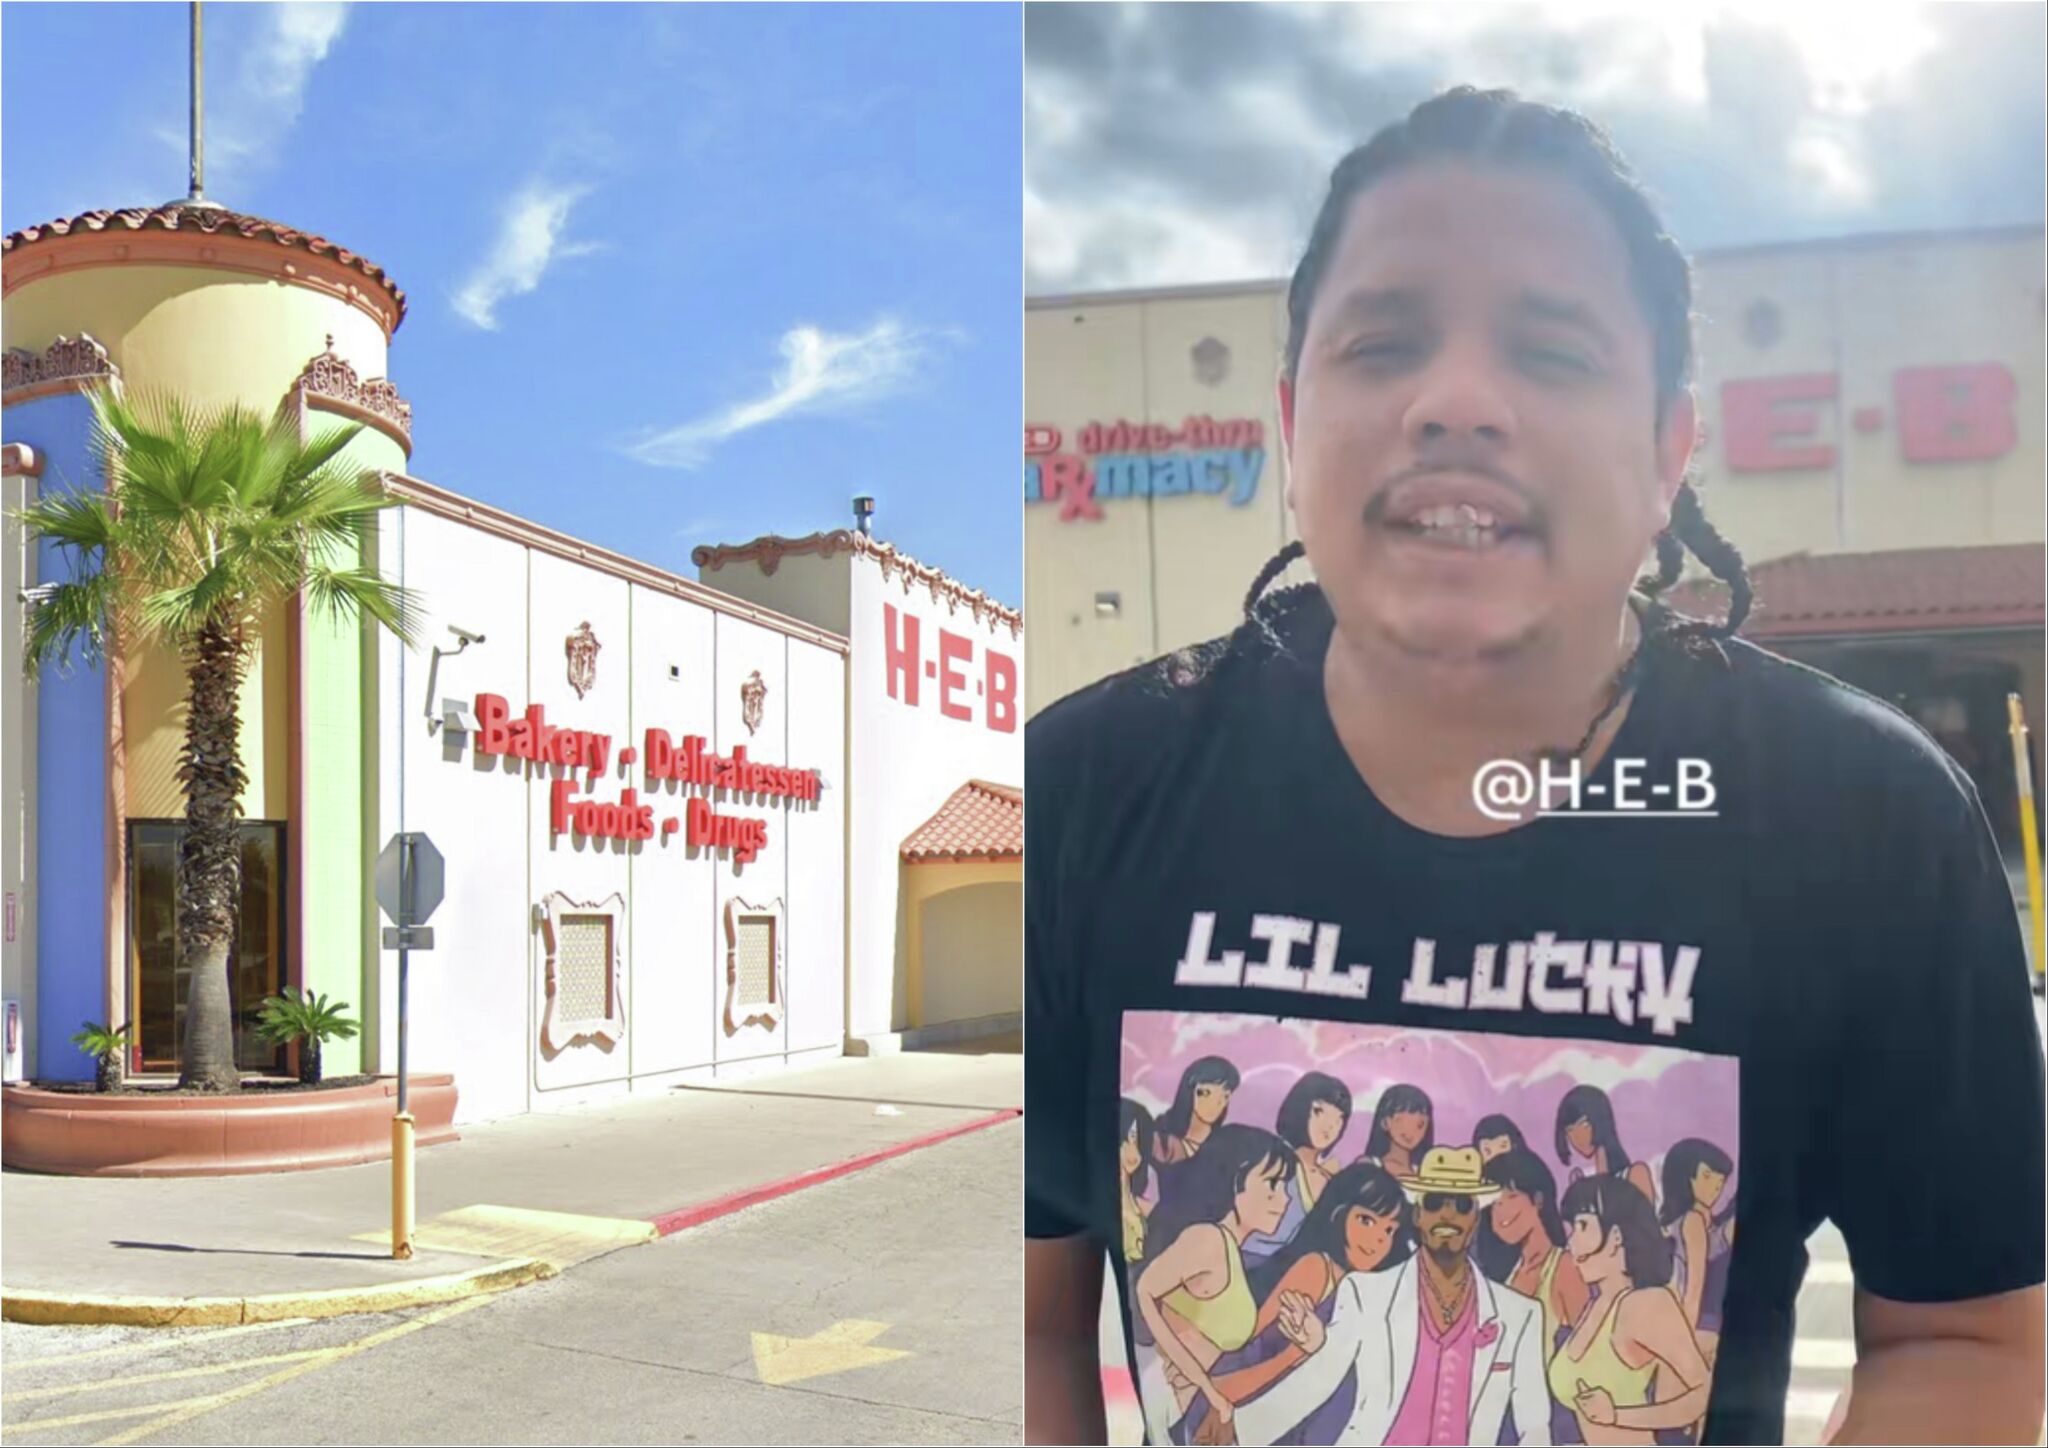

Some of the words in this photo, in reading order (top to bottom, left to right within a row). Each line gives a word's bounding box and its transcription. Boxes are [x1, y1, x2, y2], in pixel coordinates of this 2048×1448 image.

[1078, 414, 1264, 454] drive-thru
[475, 693, 611, 778] Bakery
[645, 727, 817, 800] Delicatessen
[550, 780, 653, 839] Foods
[686, 797, 768, 863] Drugs
[1174, 911, 1372, 999] LIL
[1401, 931, 1701, 1036] LUCKY
